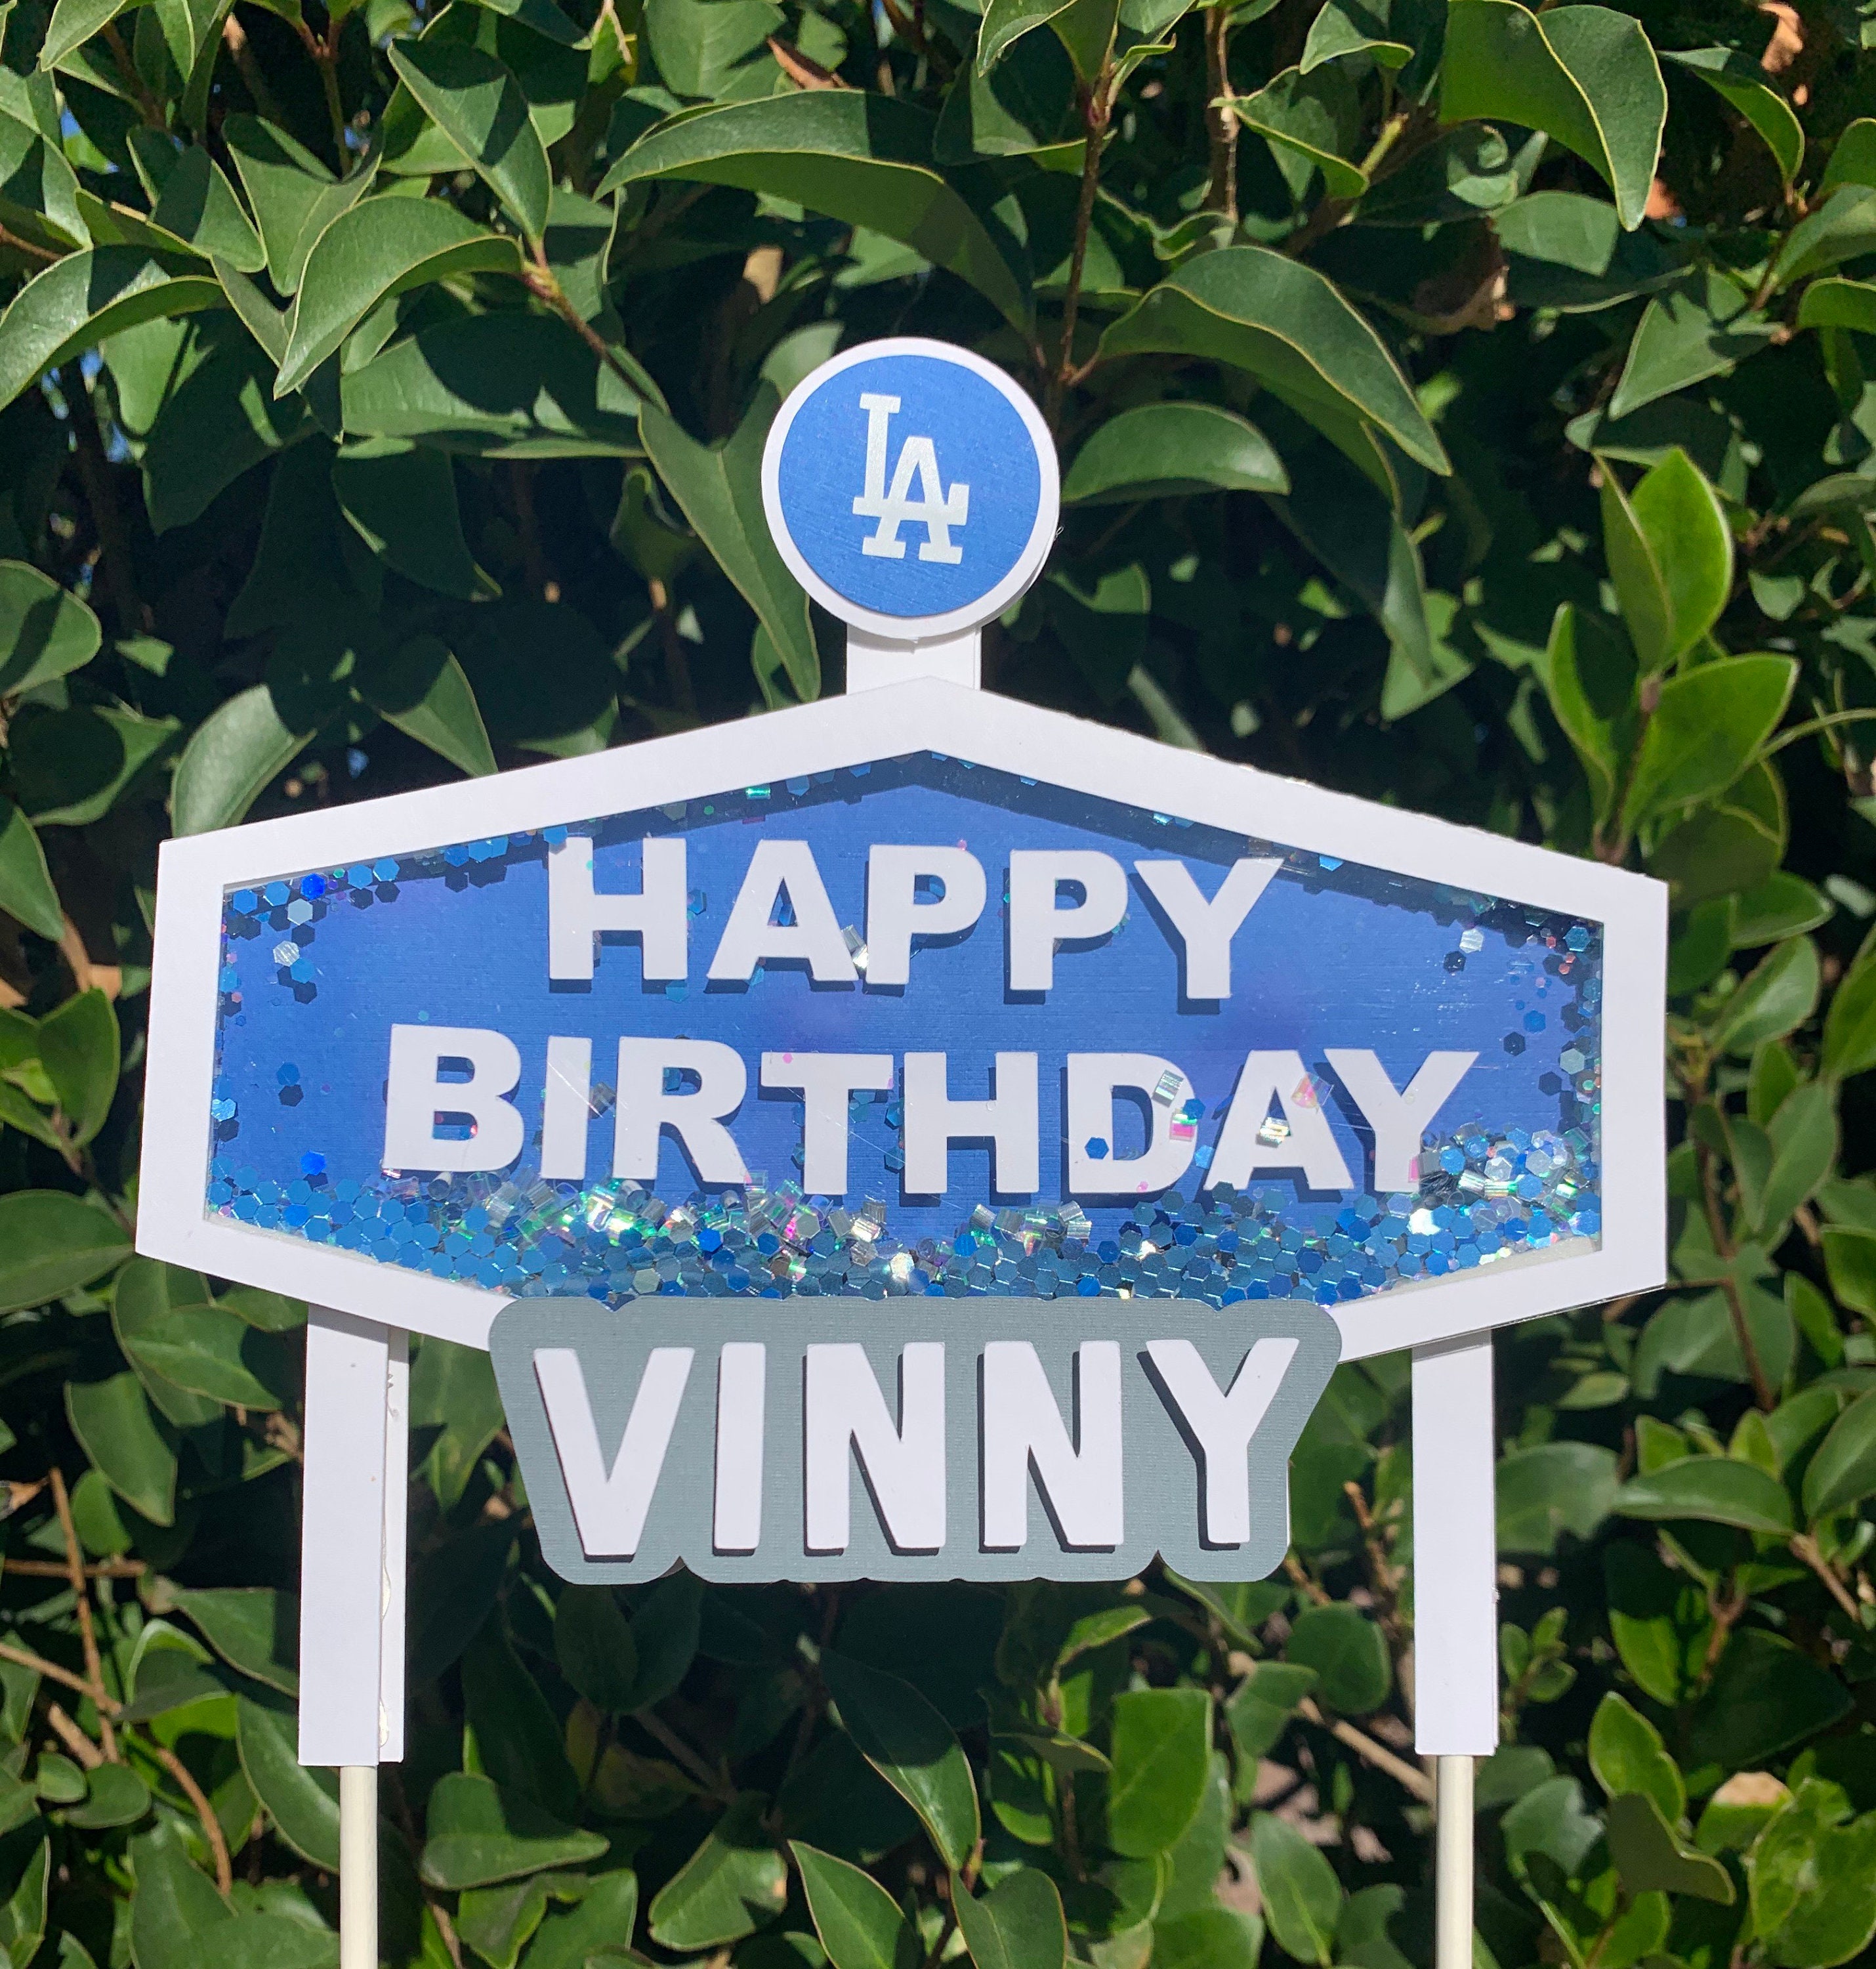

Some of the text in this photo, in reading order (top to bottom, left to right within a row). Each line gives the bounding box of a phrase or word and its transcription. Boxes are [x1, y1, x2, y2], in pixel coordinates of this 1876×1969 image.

[854, 393, 970, 564] LA
[546, 836, 1280, 1000] HAPPY
[382, 1025, 1477, 1197] BIRTHDAY
[535, 1337, 1301, 1557] VINNY
